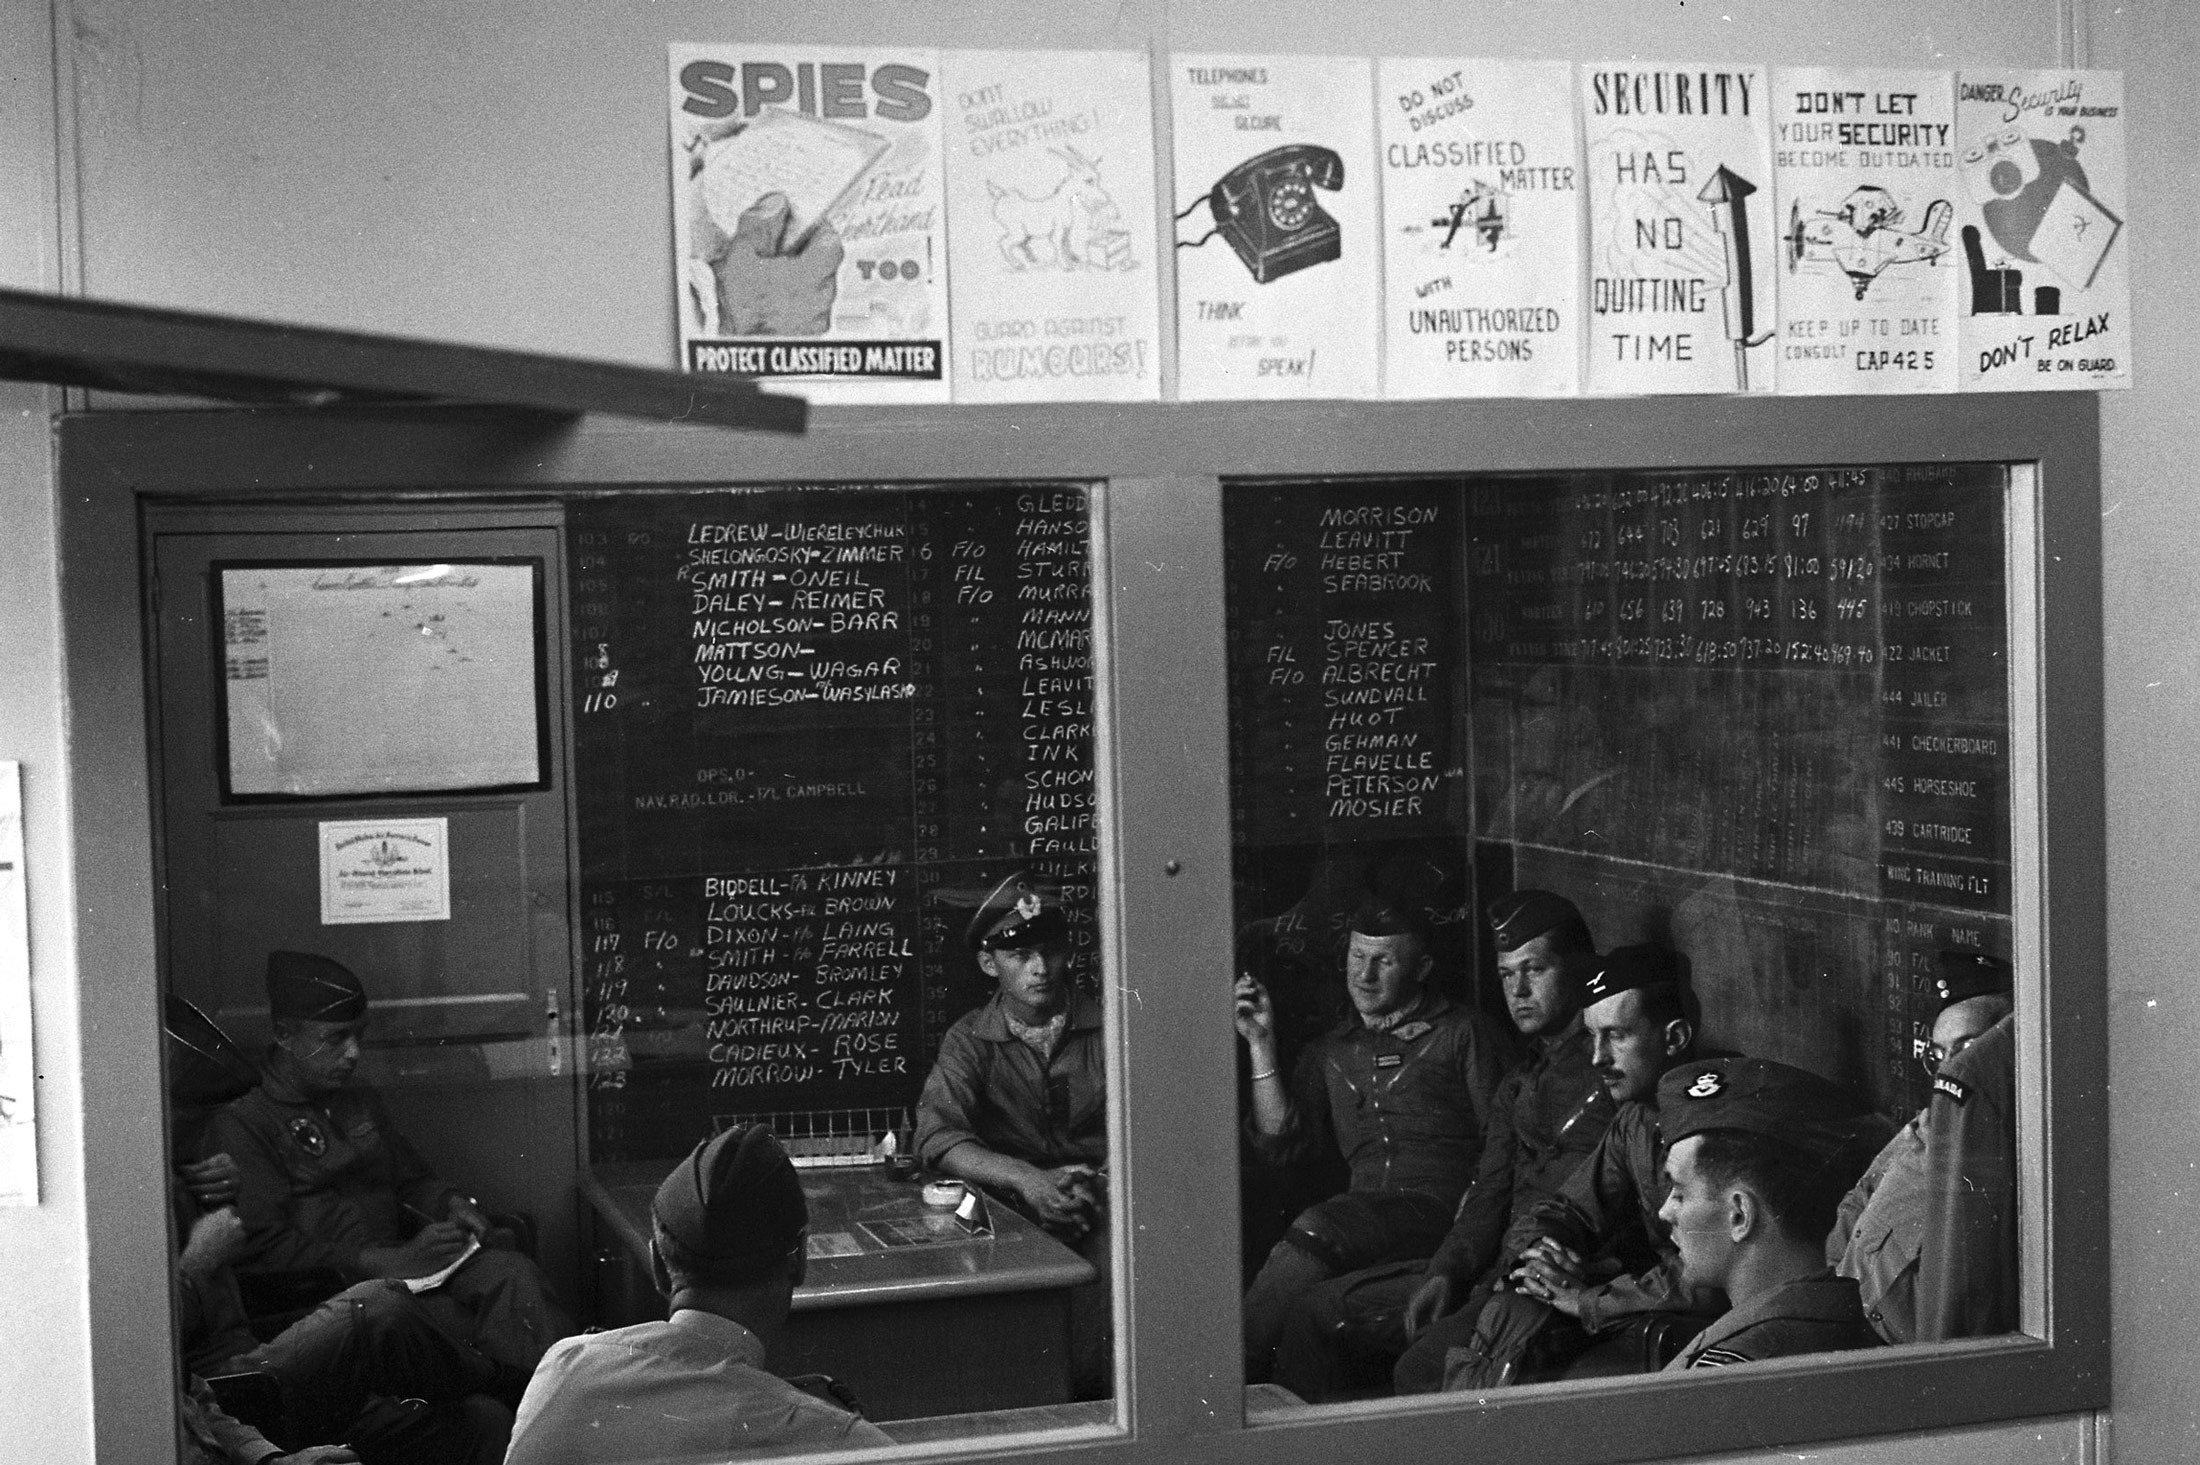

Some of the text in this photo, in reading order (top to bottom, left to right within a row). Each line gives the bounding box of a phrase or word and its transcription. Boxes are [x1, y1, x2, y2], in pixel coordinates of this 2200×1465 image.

[679, 60, 932, 123] SPIES
[1398, 71, 1464, 113] DO NOT
[1592, 72, 1755, 116] SECURITY
[1408, 96, 1475, 132] DISCUSS
[1795, 92, 1918, 115] DON'T LET
[1777, 122, 1950, 147] YOUR SECURITY
[1388, 142, 1526, 168] CLASSIFIED
[1777, 151, 1954, 169] BECOME OUTDATED
[1615, 151, 1687, 184] HAS
[1499, 167, 1575, 192] MATTER
[1635, 217, 1682, 250] NO
[1415, 277, 1453, 299] WITH
[1594, 278, 1706, 315] QUITTING
[1408, 307, 1560, 334] UNAUTHORIZED
[1787, 317, 1940, 339] KEEP UP TO DATE
[1445, 339, 1533, 362] PERSONS
[1611, 334, 1693, 362] TIME
[1785, 344, 1847, 360] CONSULT
[1979, 311, 2111, 372] DON'T RELAX
[696, 346, 937, 374] PROTECT CLASSIFIED MATTER
[2037, 358, 2116, 372] BE ON GUARD
[1016, 518, 1090, 536] HANSO
[1320, 506, 1438, 527] MORRISON
[952, 539, 1092, 559] F/O HAMILT
[1320, 530, 1413, 549] LEAVITT
[1263, 551, 1405, 572] F/O HEBERT
[1907, 552, 1950, 569] HORNET
[790, 569, 870, 588] ONEIL
[954, 564, 985, 582] F/L
[1323, 573, 1432, 594] SEABROOK
[791, 589, 886, 611] REIMER
[957, 583, 1093, 604] F/O MURRA
[1907, 600, 1973, 617] CHOPSTICK
[831, 612, 899, 634] BARR
[1324, 619, 1395, 641] JONES
[1017, 628, 1092, 650] MCMAR
[1267, 638, 1429, 663] F/L SPENCER
[1909, 646, 1950, 663] JACKET
[811, 657, 900, 680] WAGAR
[1269, 662, 1437, 685] F/O ALBRECHT
[1022, 676, 1094, 697] LEAVIT
[1324, 686, 1428, 708] SUNDVALL
[584, 693, 617, 714] 110
[1910, 691, 1948, 708] JAILER
[1328, 707, 1404, 731] HUOT
[1028, 744, 1079, 762] INK
[1325, 733, 1418, 752] GEHMAN
[1911, 735, 1997, 756] CHECKERBOARD
[1326, 752, 1433, 773] FLAVELLE
[786, 781, 867, 799] CAMPBELL
[1326, 774, 1439, 797] PETERSON
[1913, 777, 1977, 798] HORSESHOE
[1025, 793, 1097, 813] HUDSO
[1329, 796, 1422, 817] MOSIER
[1912, 823, 1973, 845] CARTRIDGE
[818, 870, 896, 892] KINNEY
[1915, 867, 1965, 891] TRAINING
[1968, 875, 1990, 895] FLT
[825, 897, 896, 916] BROWN
[644, 930, 679, 950] F/O
[823, 921, 894, 942] LAING
[1951, 927, 1982, 948] NAME
[819, 938, 915, 963] FARRELL
[597, 954, 626, 978] 118
[815, 964, 904, 984] BROMLEY
[599, 979, 628, 1001] 119
[816, 988, 893, 1009] CLARK
[834, 1033, 899, 1056] ROSE
[832, 1057, 907, 1080] TYLER
